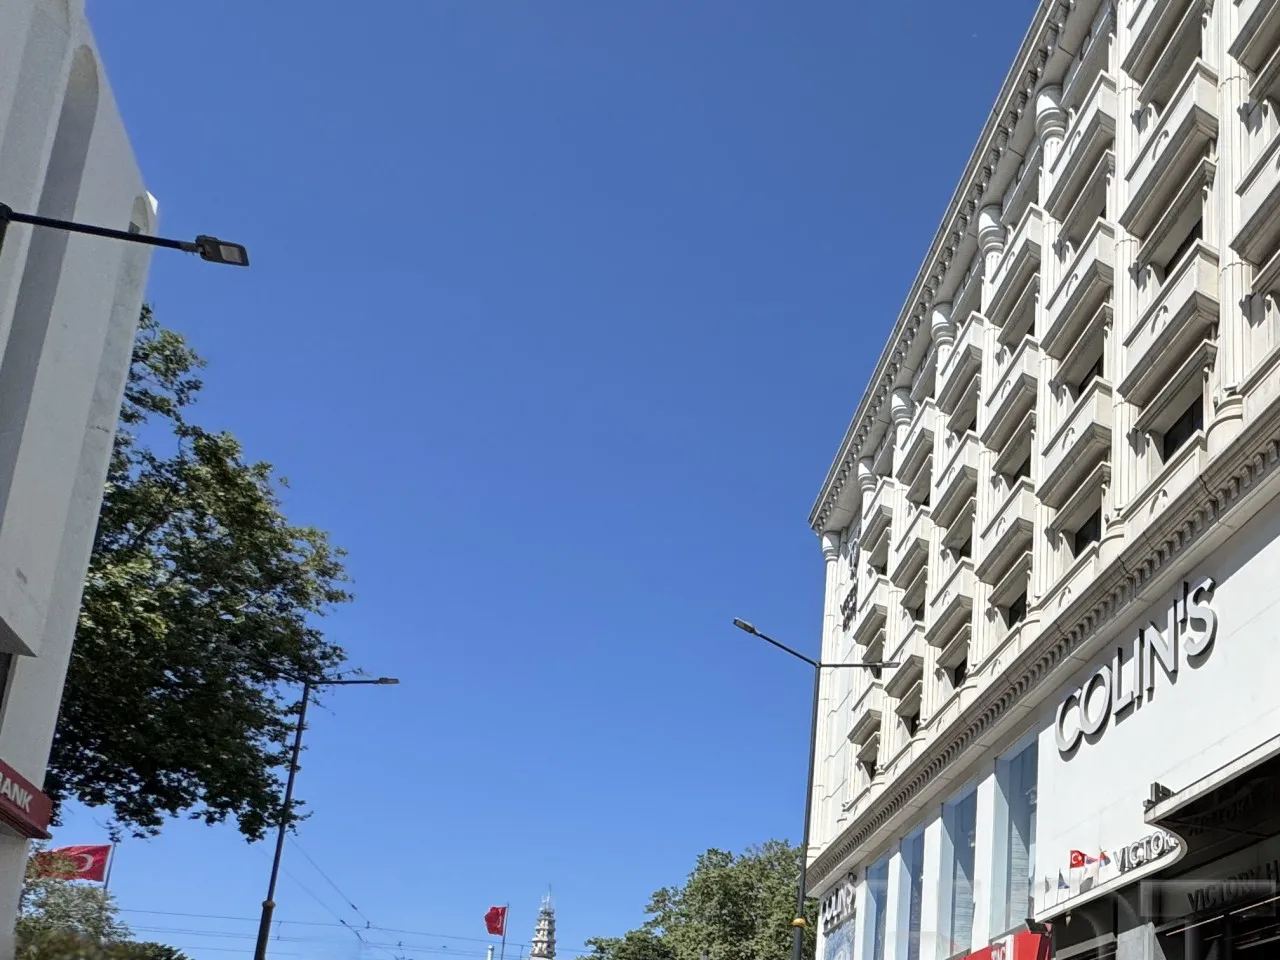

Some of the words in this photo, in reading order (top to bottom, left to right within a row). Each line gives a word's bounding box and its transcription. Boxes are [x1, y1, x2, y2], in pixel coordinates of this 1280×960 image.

[1055, 576, 1217, 752] COLIN'S
[0, 771, 33, 813] ANK
[1187, 864, 1261, 911] VICTORY
